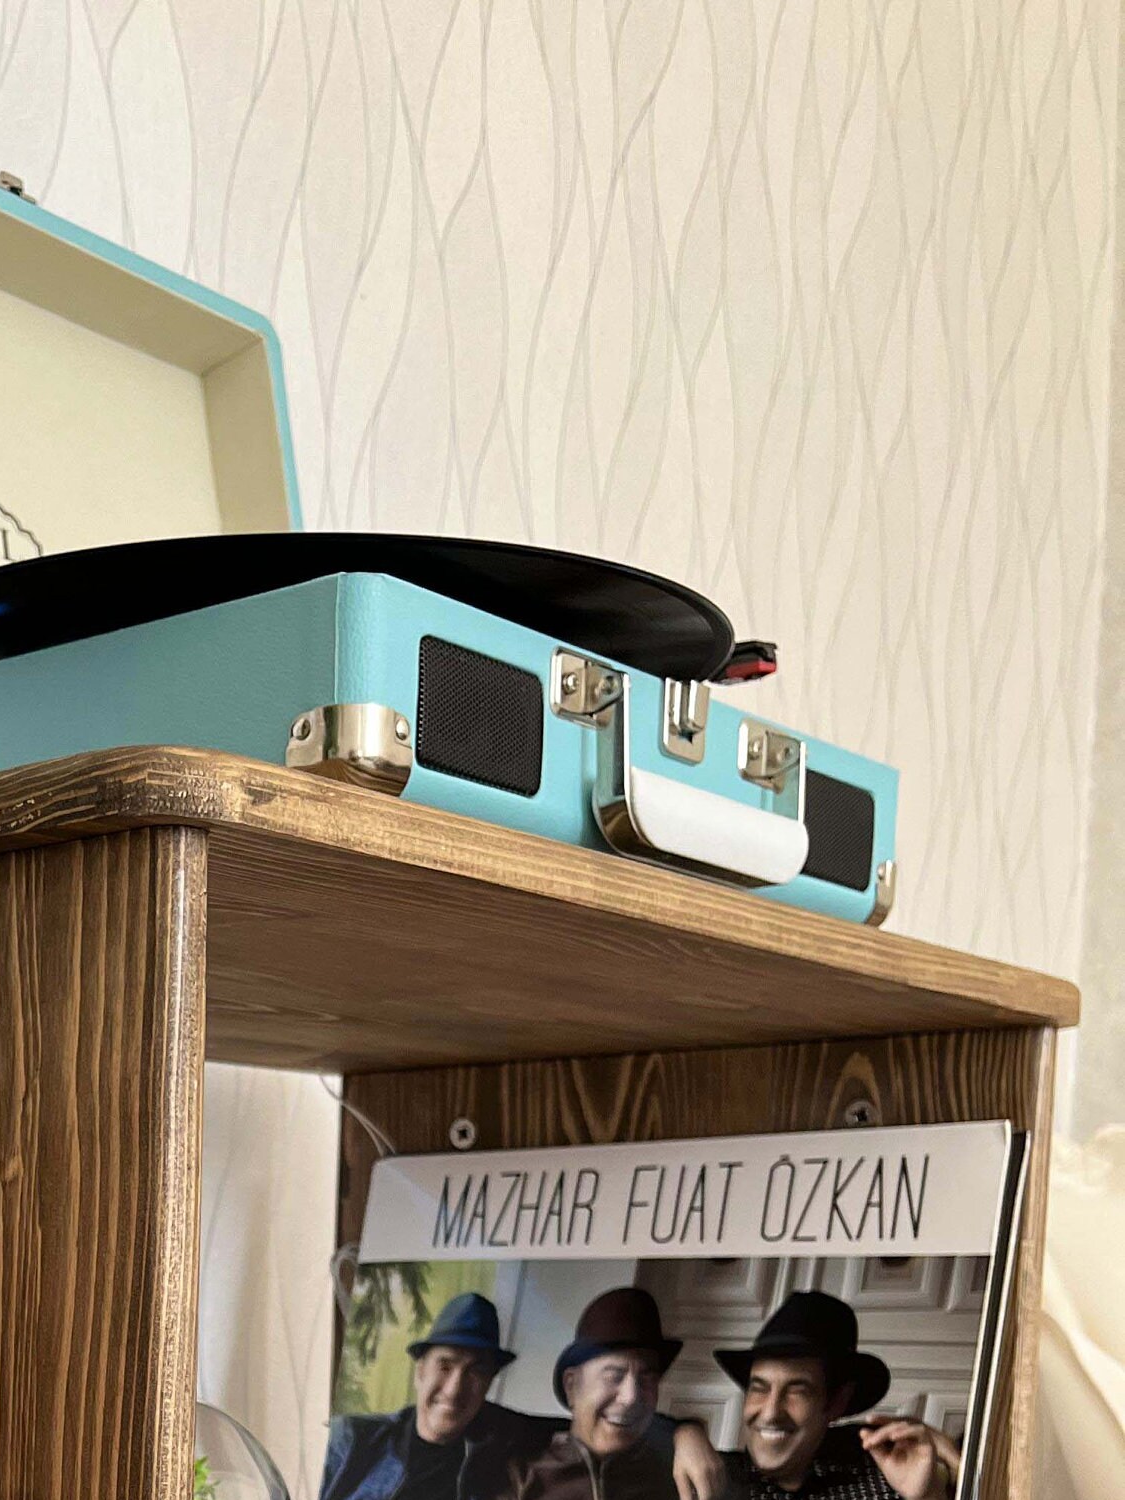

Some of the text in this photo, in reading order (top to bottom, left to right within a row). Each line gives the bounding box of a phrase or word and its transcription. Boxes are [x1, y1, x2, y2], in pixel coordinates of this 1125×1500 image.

[431, 1153, 930, 1249] MAZHAR FUAT ÖZKAN
